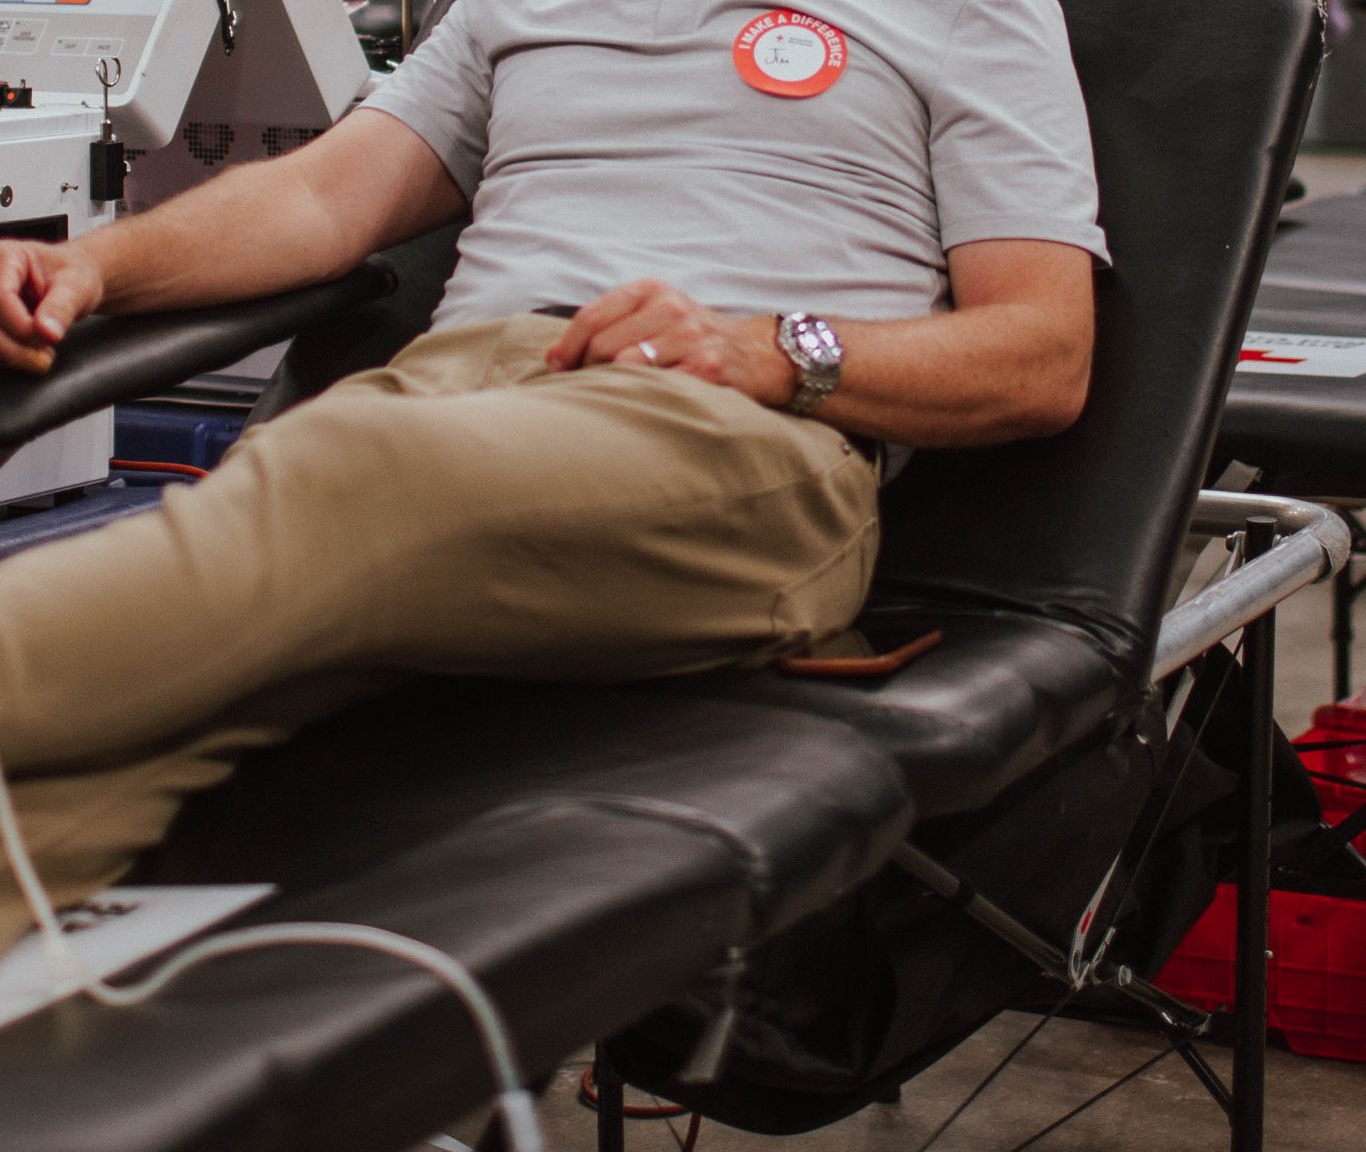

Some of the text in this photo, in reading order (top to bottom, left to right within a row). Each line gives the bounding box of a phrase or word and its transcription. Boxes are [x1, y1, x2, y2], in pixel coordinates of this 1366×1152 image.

[742, 17, 774, 44] MAKE
[778, 14, 787, 24] A
[791, 13, 843, 67] DIFFERENCE
